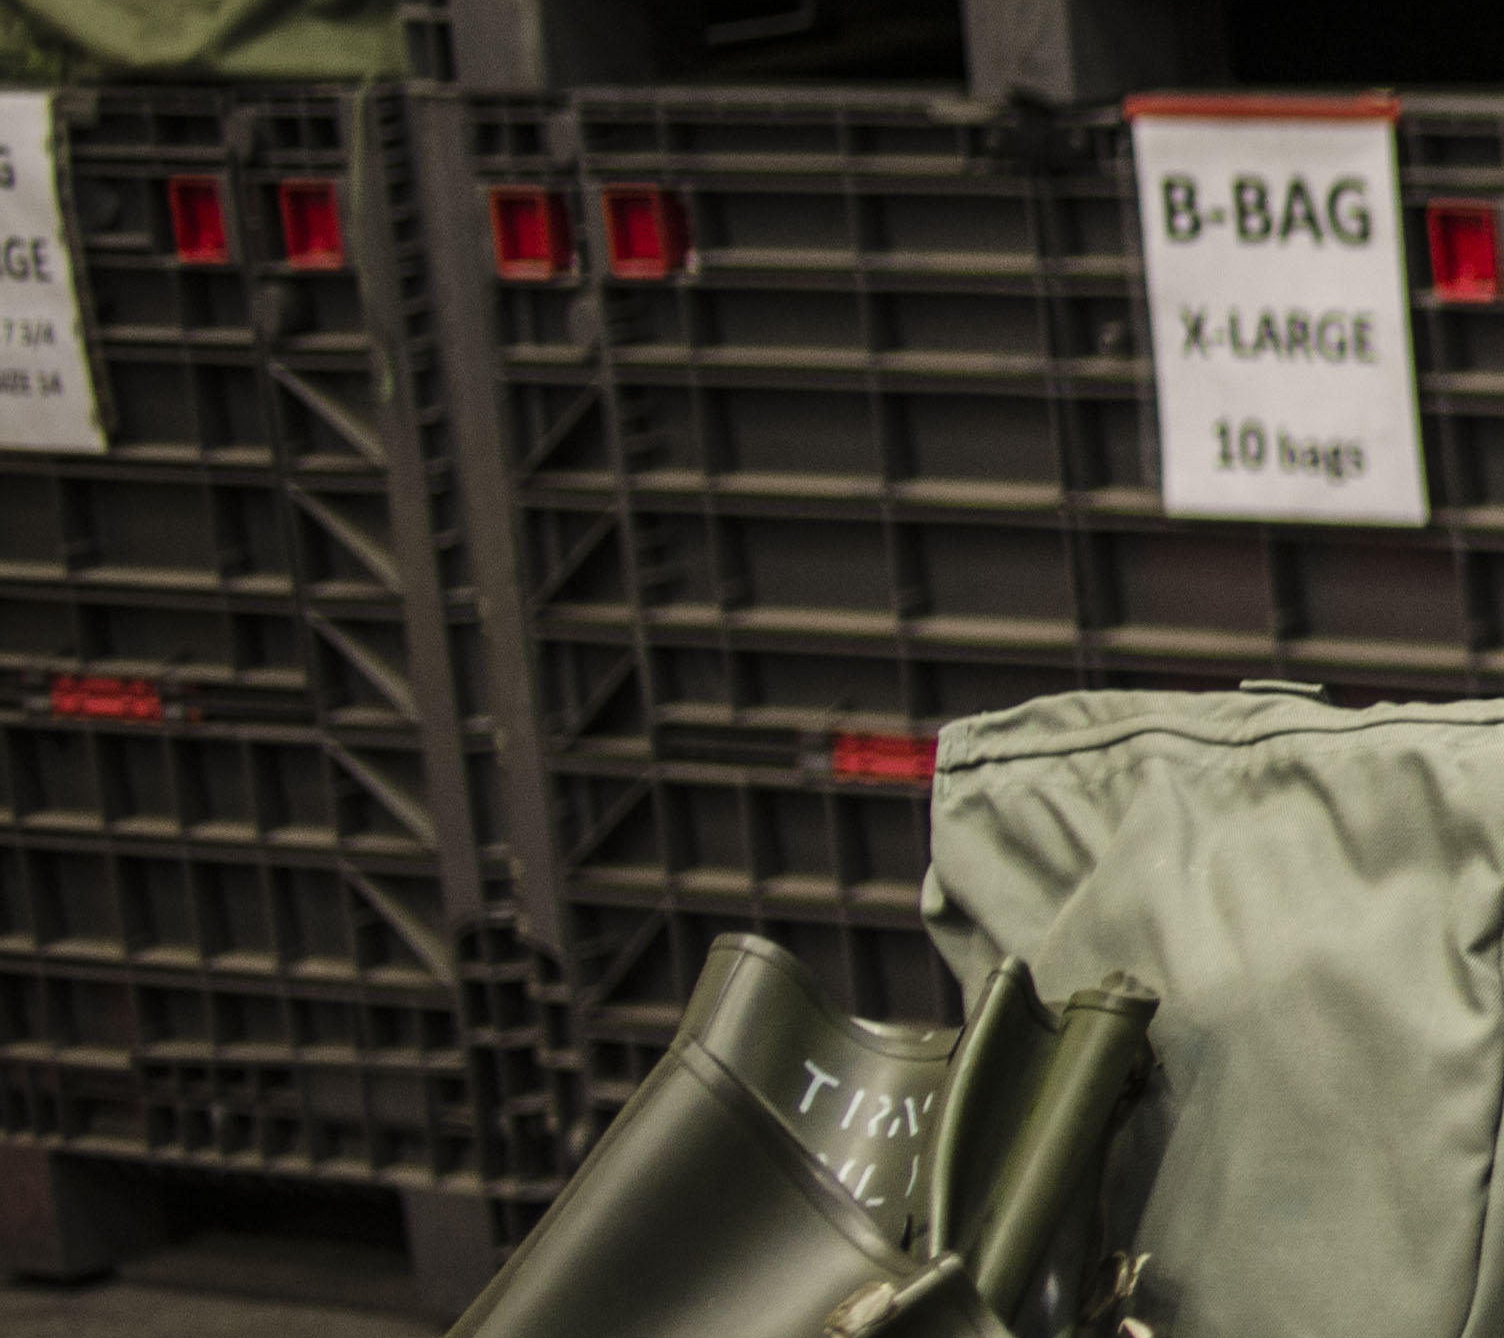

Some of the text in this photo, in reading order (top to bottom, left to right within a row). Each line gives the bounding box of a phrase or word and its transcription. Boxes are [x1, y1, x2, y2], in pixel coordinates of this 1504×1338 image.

[1161, 175, 1373, 247] B-BAG
[1179, 306, 1380, 363] X-LARGE
[1215, 419, 1365, 482] 10 bags
